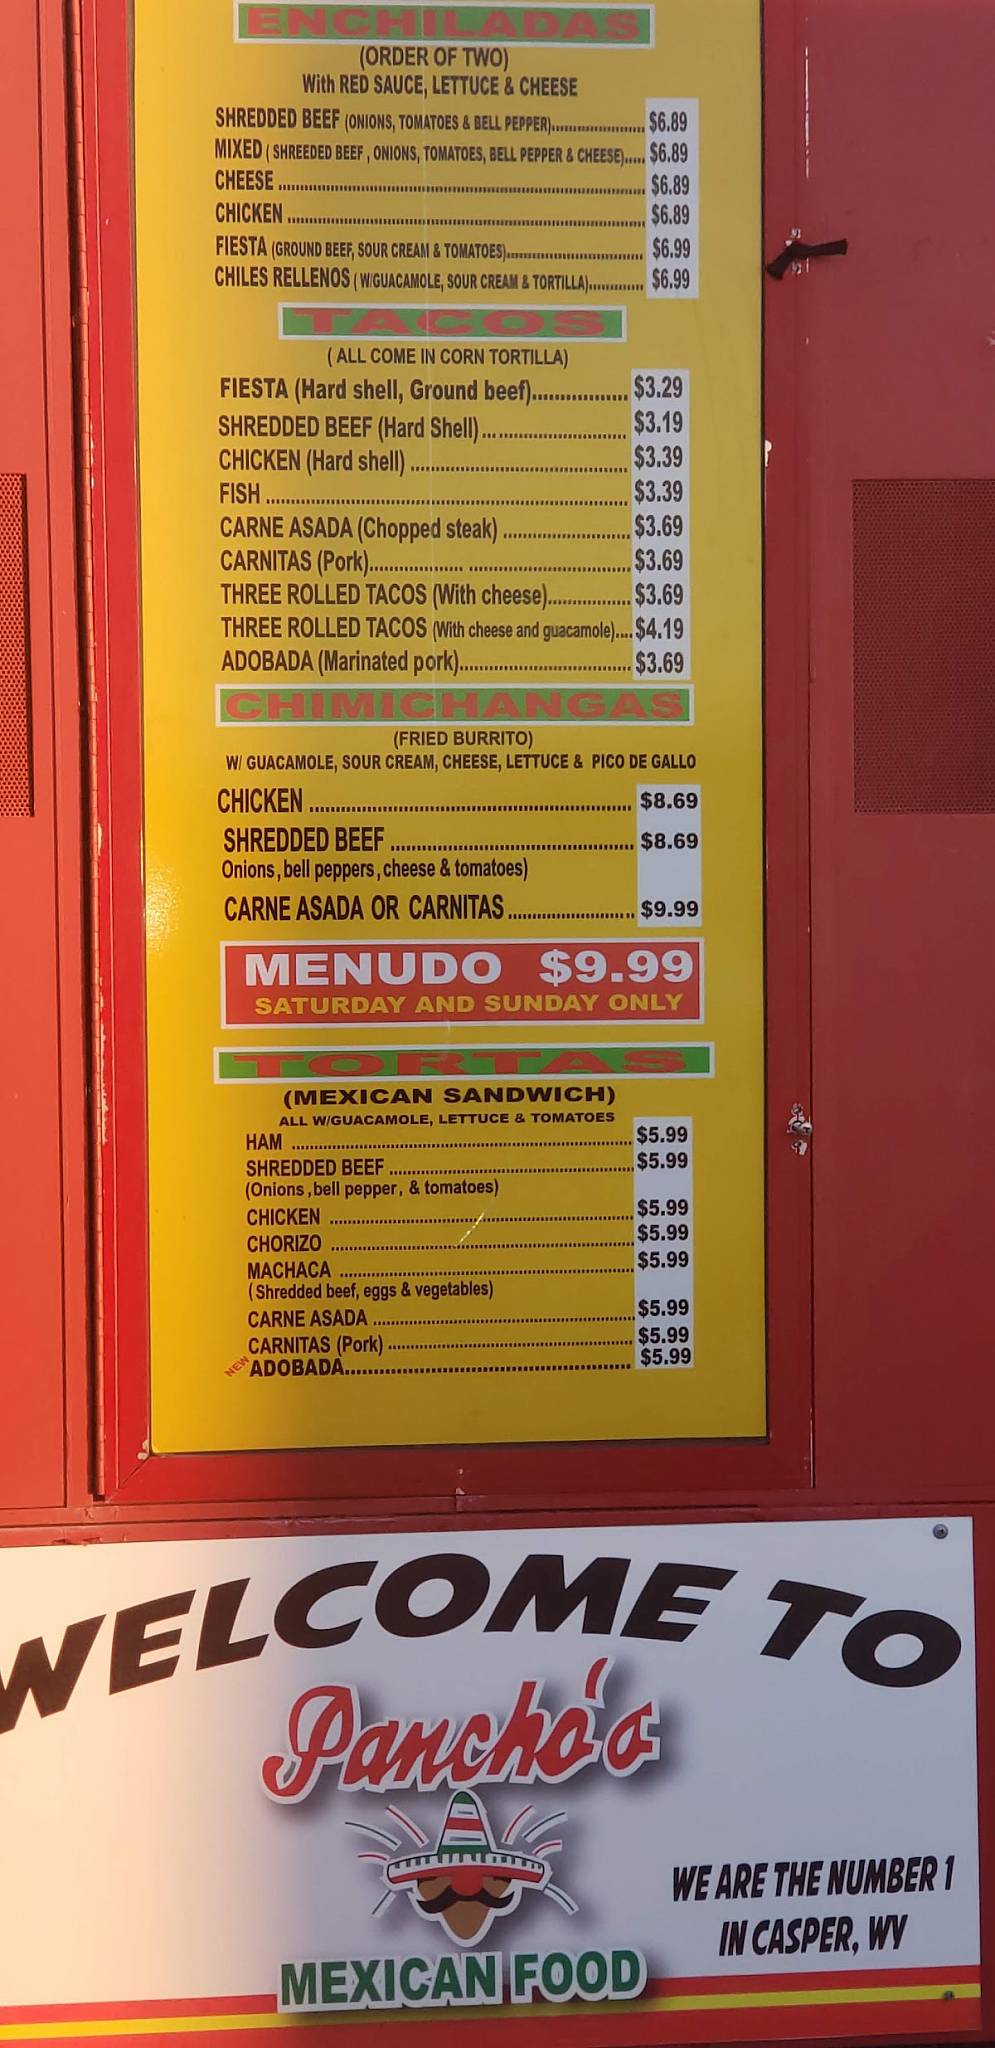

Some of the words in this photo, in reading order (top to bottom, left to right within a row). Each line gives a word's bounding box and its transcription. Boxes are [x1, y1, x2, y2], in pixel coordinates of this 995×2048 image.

[246, 7, 641, 40] ENCHILADAS
[360, 46, 429, 71] (ORDER
[434, 46, 458, 67] OF
[462, 47, 509, 72] TWO)
[302, 74, 335, 94] With
[340, 74, 369, 94] RED
[374, 74, 427, 99] SAUCE,
[432, 75, 499, 95] LETTUCE
[504, 76, 514, 96] &
[520, 76, 578, 97] CHEESE
[216, 107, 297, 128] SHREDDED
[302, 108, 340, 129] BEEF
[345, 114, 395, 133] (ONIONS,
[398, 114, 459, 130] TOMATOES
[462, 115, 471, 130] &
[474, 115, 502, 131] BELL
[649, 111, 687, 133] $6.89
[215, 169, 274, 191] CHEESE
[651, 173, 690, 197] $6.89
[216, 202, 282, 224] CHICKEN
[651, 203, 690, 227] $6.89
[216, 235, 267, 256] FIESTA
[272, 241, 322, 260] (GROUND
[325, 242, 354, 261] BEEF,
[358, 242, 388, 258] SOUR
[391, 242, 429, 259] CREAM
[433, 243, 441, 258] &
[652, 236, 690, 261] $6.99
[293, 308, 606, 336] TACOS
[221, 377, 289, 399] FIESTA
[295, 377, 346, 405] (Hard
[353, 379, 403, 405] shell,
[410, 379, 477, 400] Ground
[634, 374, 683, 401] $3.29
[219, 415, 320, 437] SHREDDED
[325, 416, 373, 437] BEEF
[378, 416, 424, 443] (Hard
[431, 416, 479, 444] Shell)
[634, 409, 683, 436] $3.19
[219, 449, 301, 471] CHICKEN
[307, 449, 353, 477] (Hard
[358, 449, 405, 477] shell)
[634, 444, 683, 470] $3.39
[220, 482, 260, 504] FISH
[634, 479, 683, 505] $3.39
[220, 516, 284, 538] CARNE
[289, 516, 353, 538] ASADA
[358, 516, 441, 544] (Chopped
[446, 517, 497, 544] steak)
[635, 513, 683, 539] $3.69
[221, 550, 312, 572] CARNITAS
[635, 548, 683, 574] $3.69
[221, 583, 282, 604] THREE
[287, 583, 360, 605] ROLLED
[365, 583, 427, 605] TACOS
[433, 583, 476, 610] (With
[635, 582, 683, 608] $3.69
[221, 616, 282, 638] THREE
[288, 616, 360, 638] ROLLED
[365, 616, 427, 638] TACOS
[433, 621, 465, 643] (With
[468, 621, 513, 638] cheese
[516, 621, 539, 638] and
[635, 616, 683, 642] $4.19
[221, 650, 314, 671] ADOBADA
[318, 649, 408, 677] (Marinated
[635, 650, 684, 676] $3.69
[225, 691, 683, 721] CHIMICHANGAS
[394, 731, 448, 750] (FRIED
[453, 730, 533, 750] BURRITO)
[226, 755, 242, 770] W/
[247, 755, 338, 773] GUACAMOLE,
[342, 754, 381, 770] SOUR
[385, 754, 438, 773] CREAM,
[443, 754, 502, 773] CHEESE,
[506, 754, 569, 769] LETTUCE
[573, 754, 583, 769] &
[592, 754, 625, 769] PICO
[629, 754, 647, 769] DE
[651, 754, 696, 769] GALLO
[218, 788, 302, 813] CHICKEN
[640, 791, 698, 811] $8.69
[224, 827, 329, 853] SHREDDED
[335, 827, 384, 851] BEEF
[641, 832, 698, 851] $8.69
[225, 896, 291, 921] CARNE
[296, 895, 364, 921] ASADA
[371, 895, 399, 920] OR
[409, 894, 504, 920] CARNITAS
[641, 900, 698, 920] $9.99
[245, 951, 503, 987] MENUDO
[538, 948, 695, 987] $9.99
[255, 996, 406, 1016] SATURDAY
[415, 996, 476, 1013] AND
[484, 994, 600, 1013] SUNDAY
[608, 993, 683, 1012] ONLY
[233, 1049, 689, 1078] TORTAS
[284, 1088, 432, 1110] (MEXICAN
[443, 1086, 615, 1106] SANDWICH)
[279, 1116, 308, 1126] ALL
[312, 1114, 433, 1127] W/GUACAMOLE,
[439, 1113, 509, 1124] LETTUCE
[514, 1113, 526, 1123] &
[530, 1112, 615, 1123] TOMATOES
[246, 1133, 282, 1150] HAM
[636, 1125, 688, 1145] $5.99
[246, 1159, 337, 1177] SHREDDED
[342, 1158, 384, 1176] BEEF
[637, 1151, 688, 1171] $5.99
[247, 1208, 320, 1226] CHICKEN
[637, 1199, 688, 1218] $5.99
[247, 1234, 322, 1253] CHORIZO
[637, 1224, 689, 1243] $5.99
[248, 1260, 331, 1279] MACHACA
[638, 1251, 689, 1271] $5.99
[326, 1282, 359, 1301] beef,
[364, 1285, 397, 1301] eggs
[401, 1281, 411, 1297] &
[415, 1280, 493, 1300] vegetables)
[248, 1310, 305, 1328] CARNE
[310, 1309, 368, 1327] ASADA
[638, 1299, 689, 1319] $5.99
[249, 1336, 330, 1354] CARNITAS
[337, 1334, 383, 1357] (Pork)
[638, 1326, 689, 1346] $5.99
[224, 1355, 250, 1377] NEW
[641, 1347, 691, 1367] $5.99
[0, 1553, 737, 1735] WELCOME
[760, 1579, 963, 1688] TO
[262, 1657, 653, 1797] Pancho's
[673, 1865, 712, 1902] WE
[715, 1863, 768, 1899] ARE
[774, 1861, 824, 1896] THE
[827, 1856, 938, 1895] NUMBER
[944, 1855, 955, 1890] 1
[719, 1920, 748, 1956] IN
[752, 1916, 859, 1956] CASPER,
[869, 1914, 908, 1951] WY
[281, 1955, 497, 2005] MEXICAN
[515, 1950, 641, 1996] FOOD
